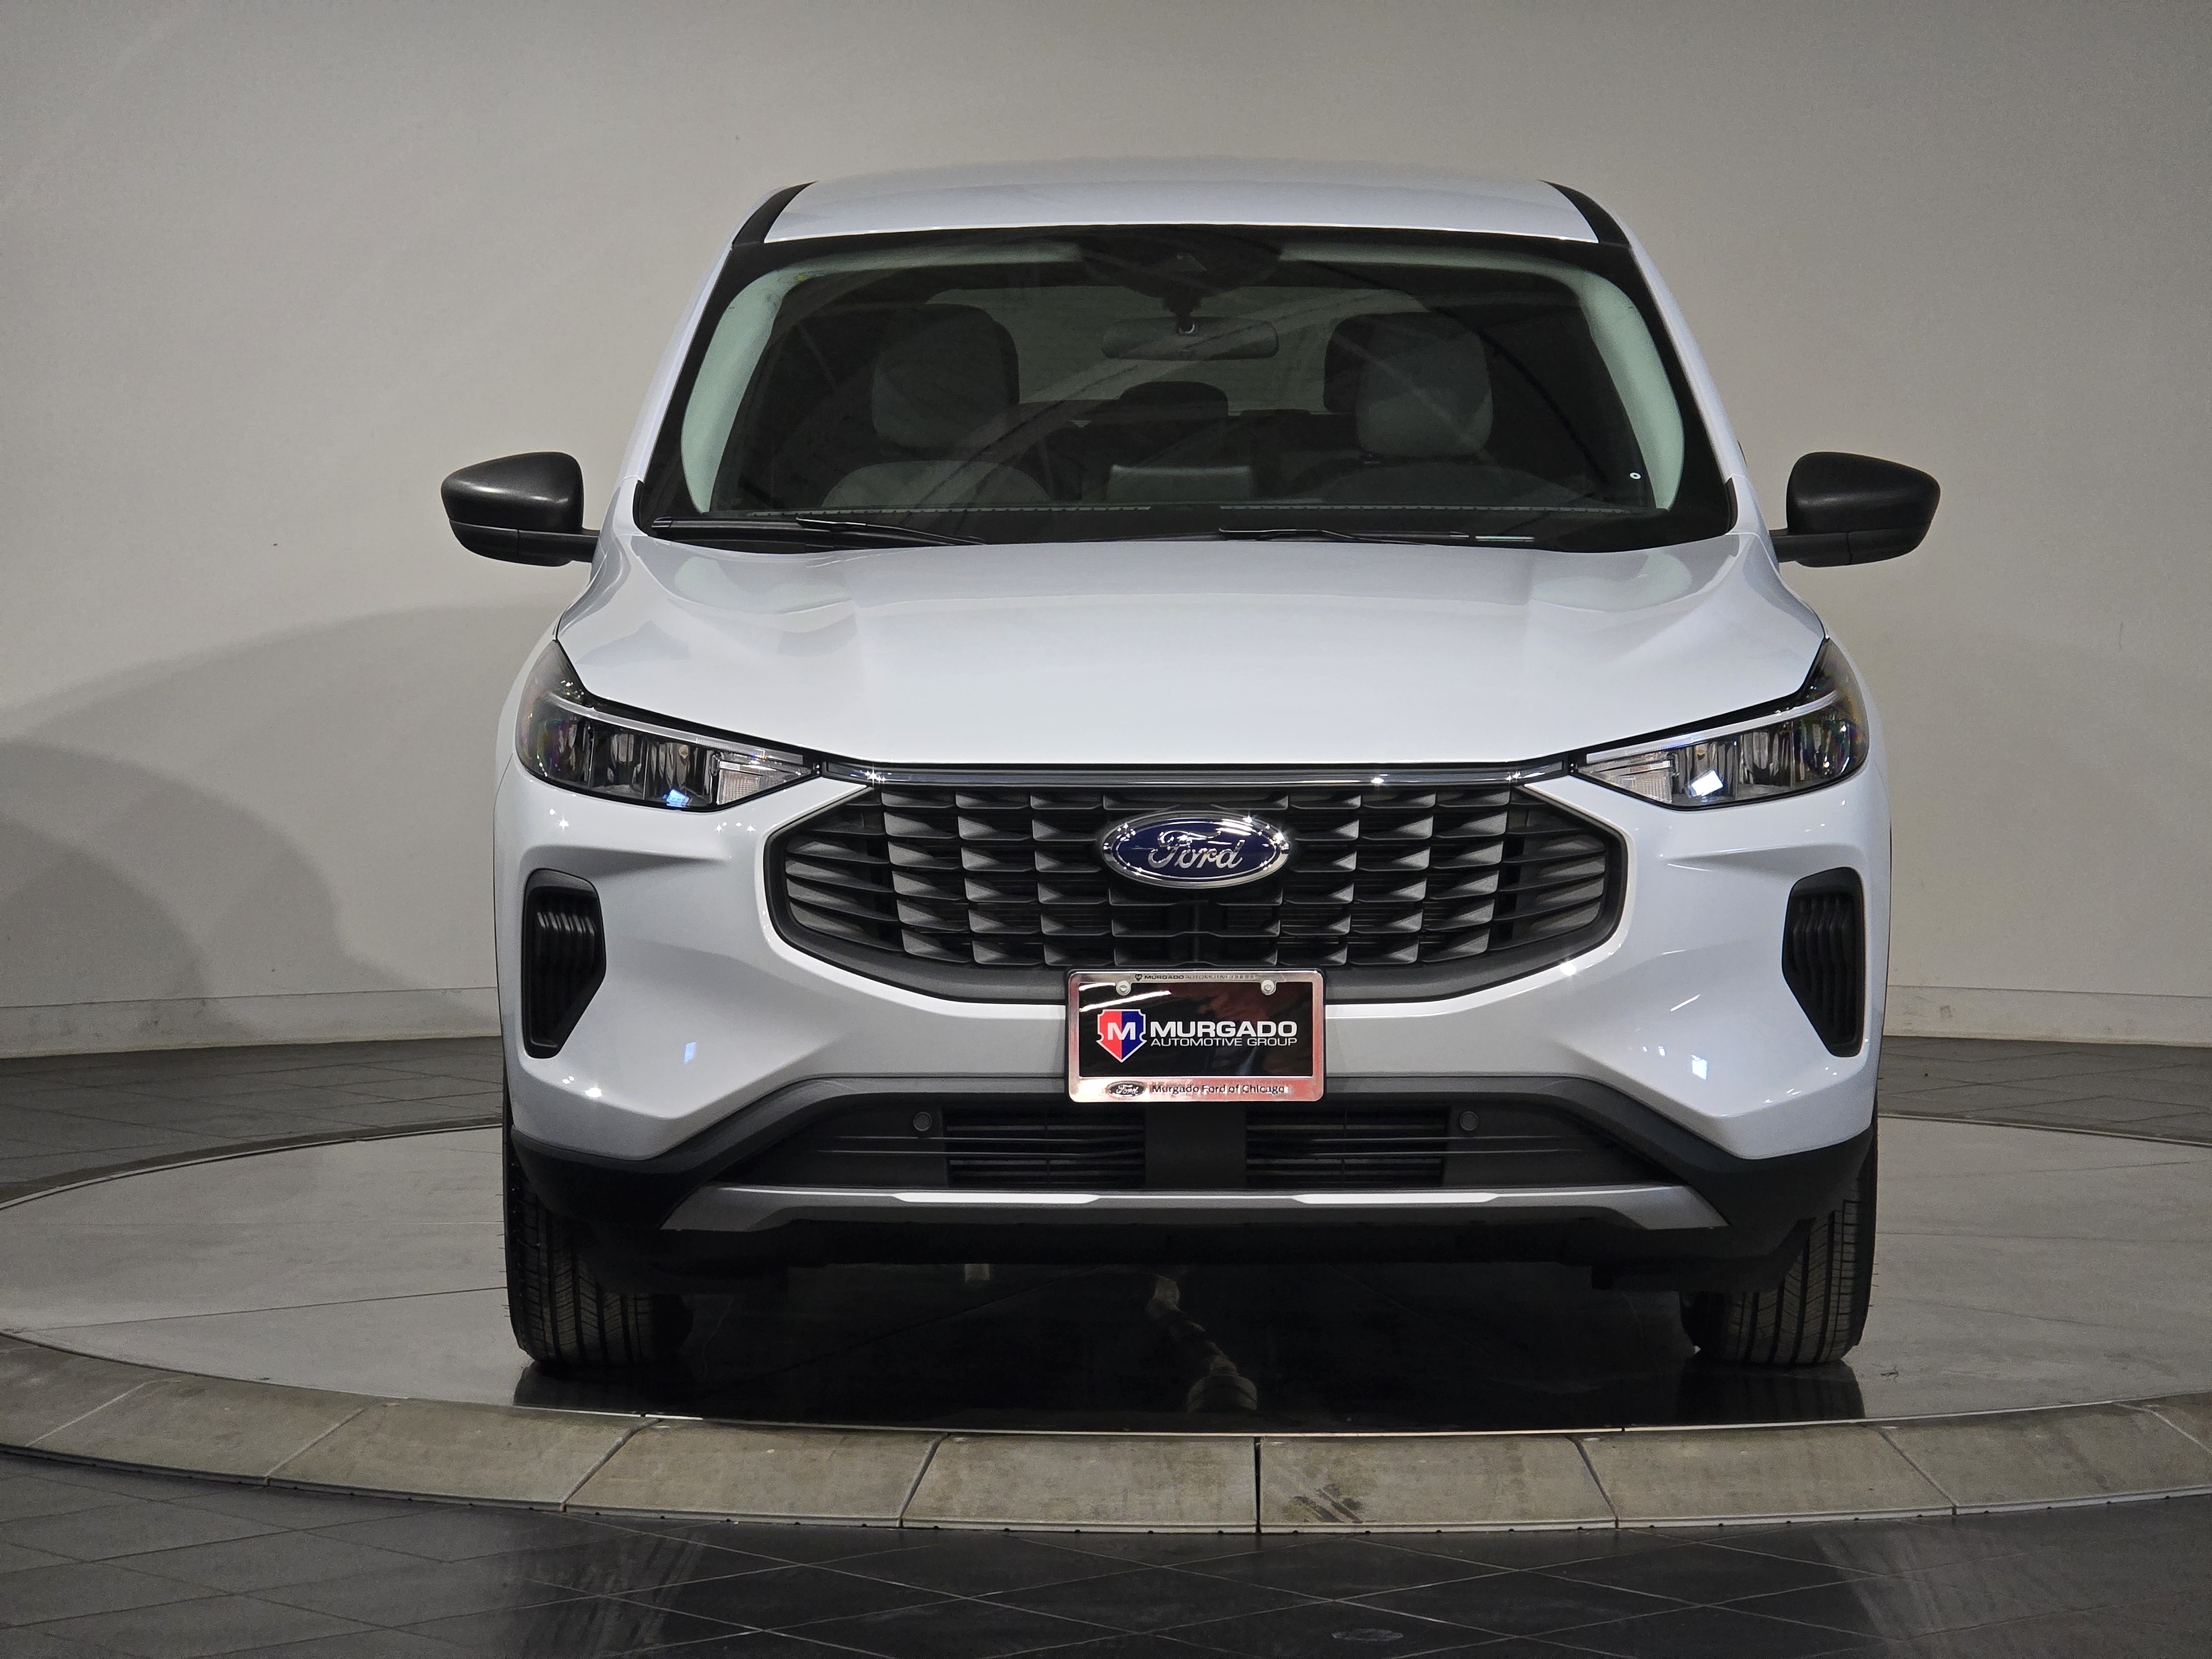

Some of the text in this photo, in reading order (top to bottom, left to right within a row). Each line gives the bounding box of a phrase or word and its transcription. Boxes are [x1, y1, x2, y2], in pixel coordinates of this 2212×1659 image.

[1148, 830, 1245, 869] Ford
[1107, 1022, 1136, 1040] M
[1150, 1021, 1297, 1037] MURGADO
[1150, 1038, 1297, 1047] AUTOMOTIVE GROUP
[1115, 1084, 1139, 1094] Ford
[1152, 1084, 1285, 1094] Murgado Ford of Chicago
